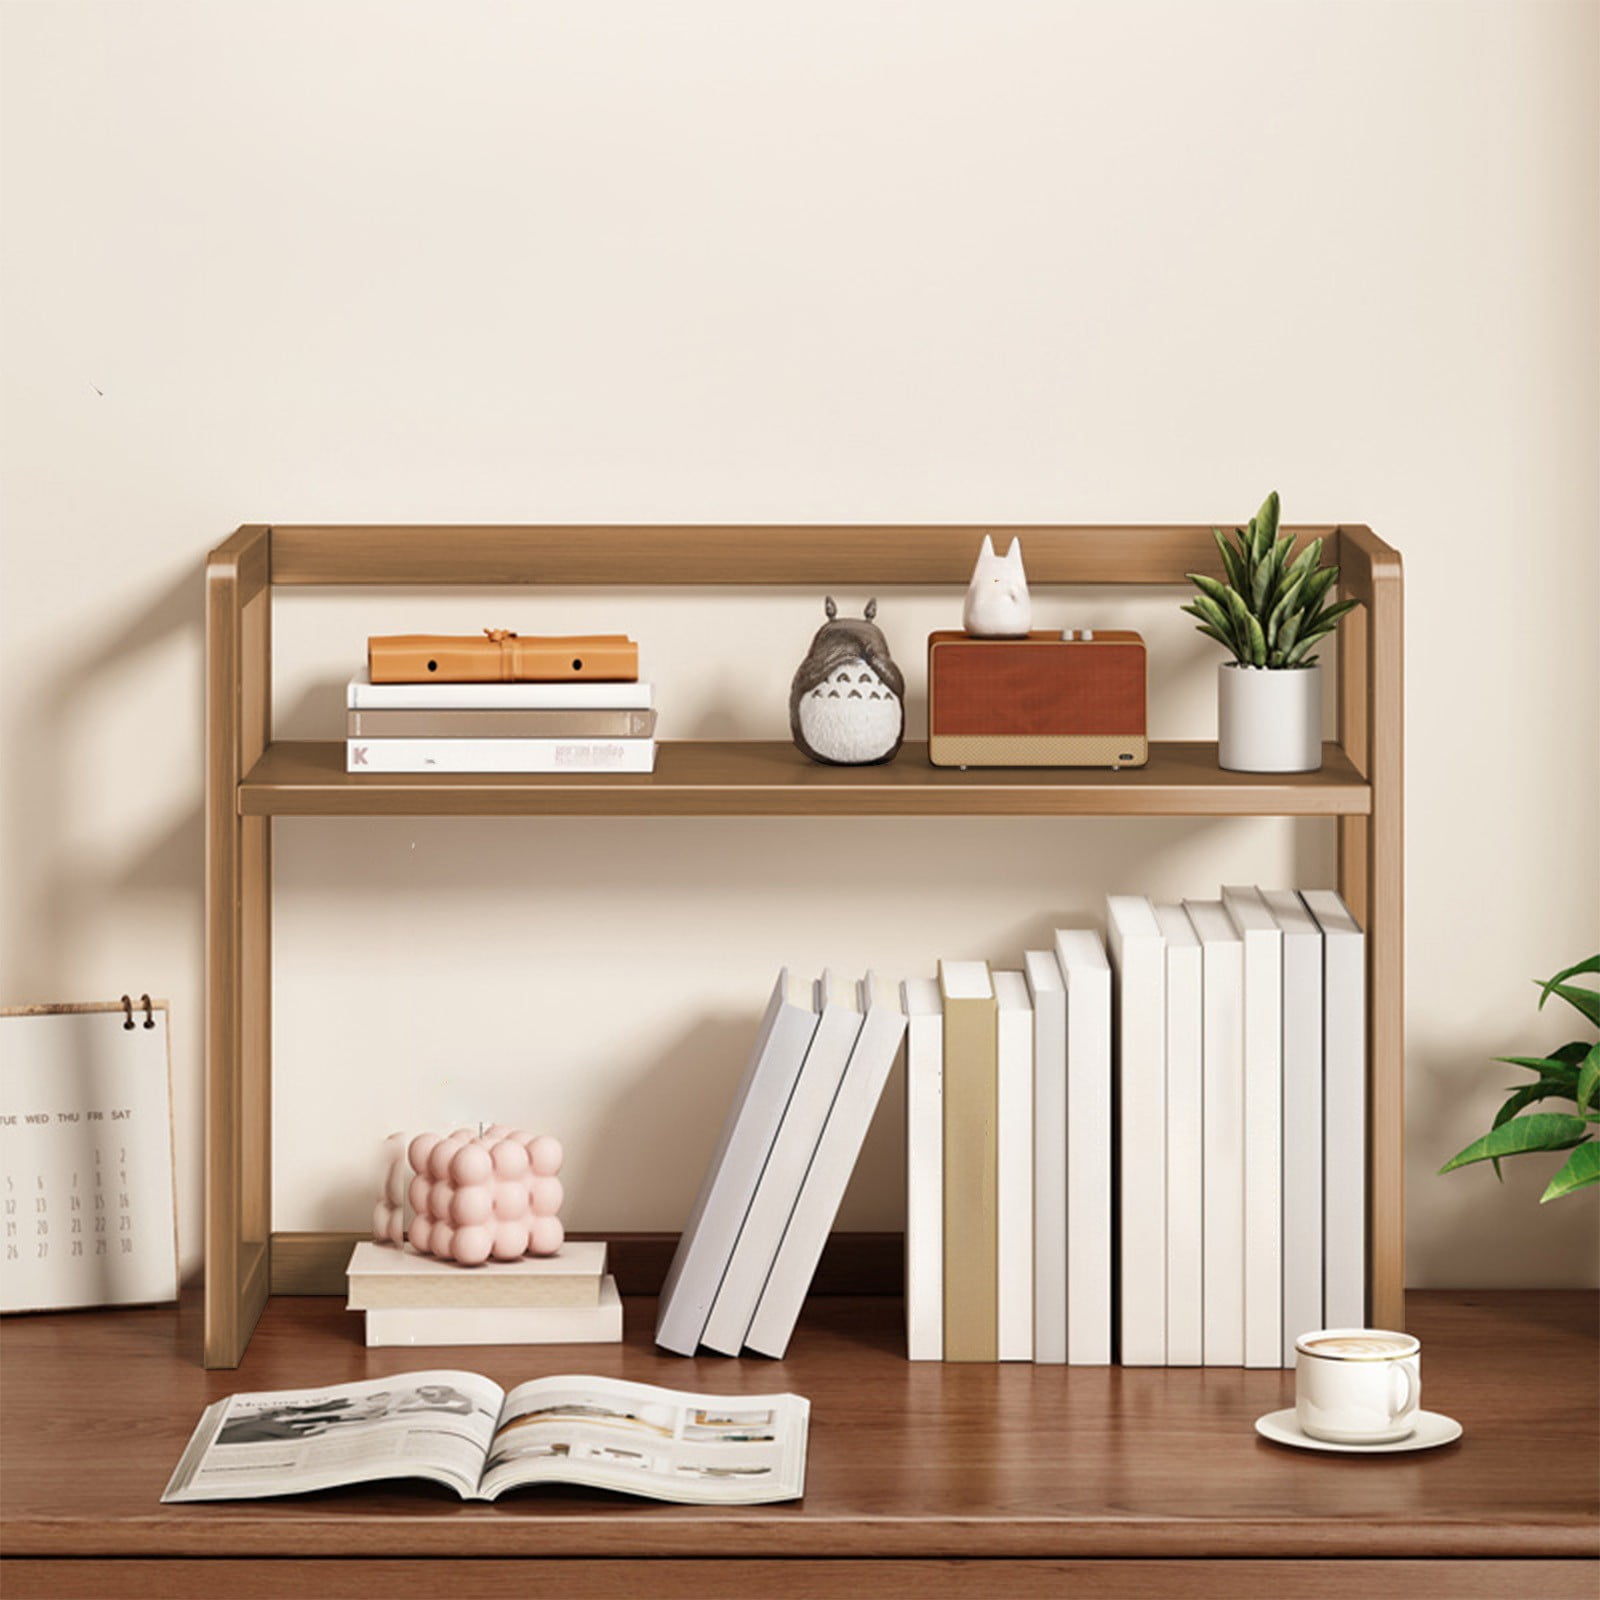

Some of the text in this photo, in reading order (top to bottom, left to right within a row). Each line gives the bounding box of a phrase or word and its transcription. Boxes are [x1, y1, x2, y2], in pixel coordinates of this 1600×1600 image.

[353, 747, 369, 765] K
[25, 1114, 49, 1124] WED
[58, 1112, 80, 1123] THU
[87, 1111, 104, 1121] FRI
[111, 1110, 131, 1120] SAT
[71, 1218, 82, 1233] 21
